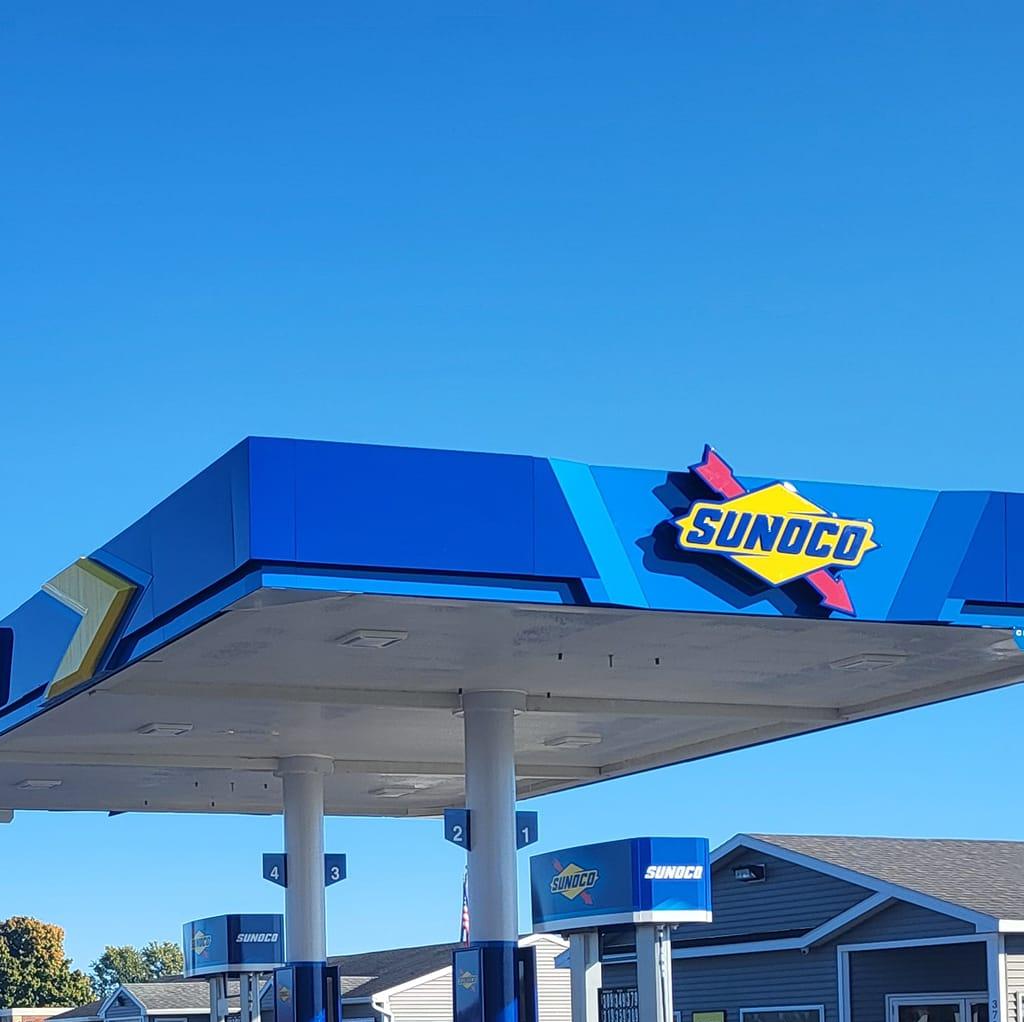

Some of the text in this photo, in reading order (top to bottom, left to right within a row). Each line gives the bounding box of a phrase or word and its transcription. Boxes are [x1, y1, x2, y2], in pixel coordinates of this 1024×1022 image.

[686, 507, 873, 561] SUNOCO
[453, 825, 463, 841] 2
[522, 827, 529, 843] 1
[270, 866, 279, 880] 4
[331, 866, 340, 880] 3
[644, 865, 704, 880] SUNOCO
[552, 871, 597, 891] SUNOCO
[236, 933, 278, 943] SUNOCO
